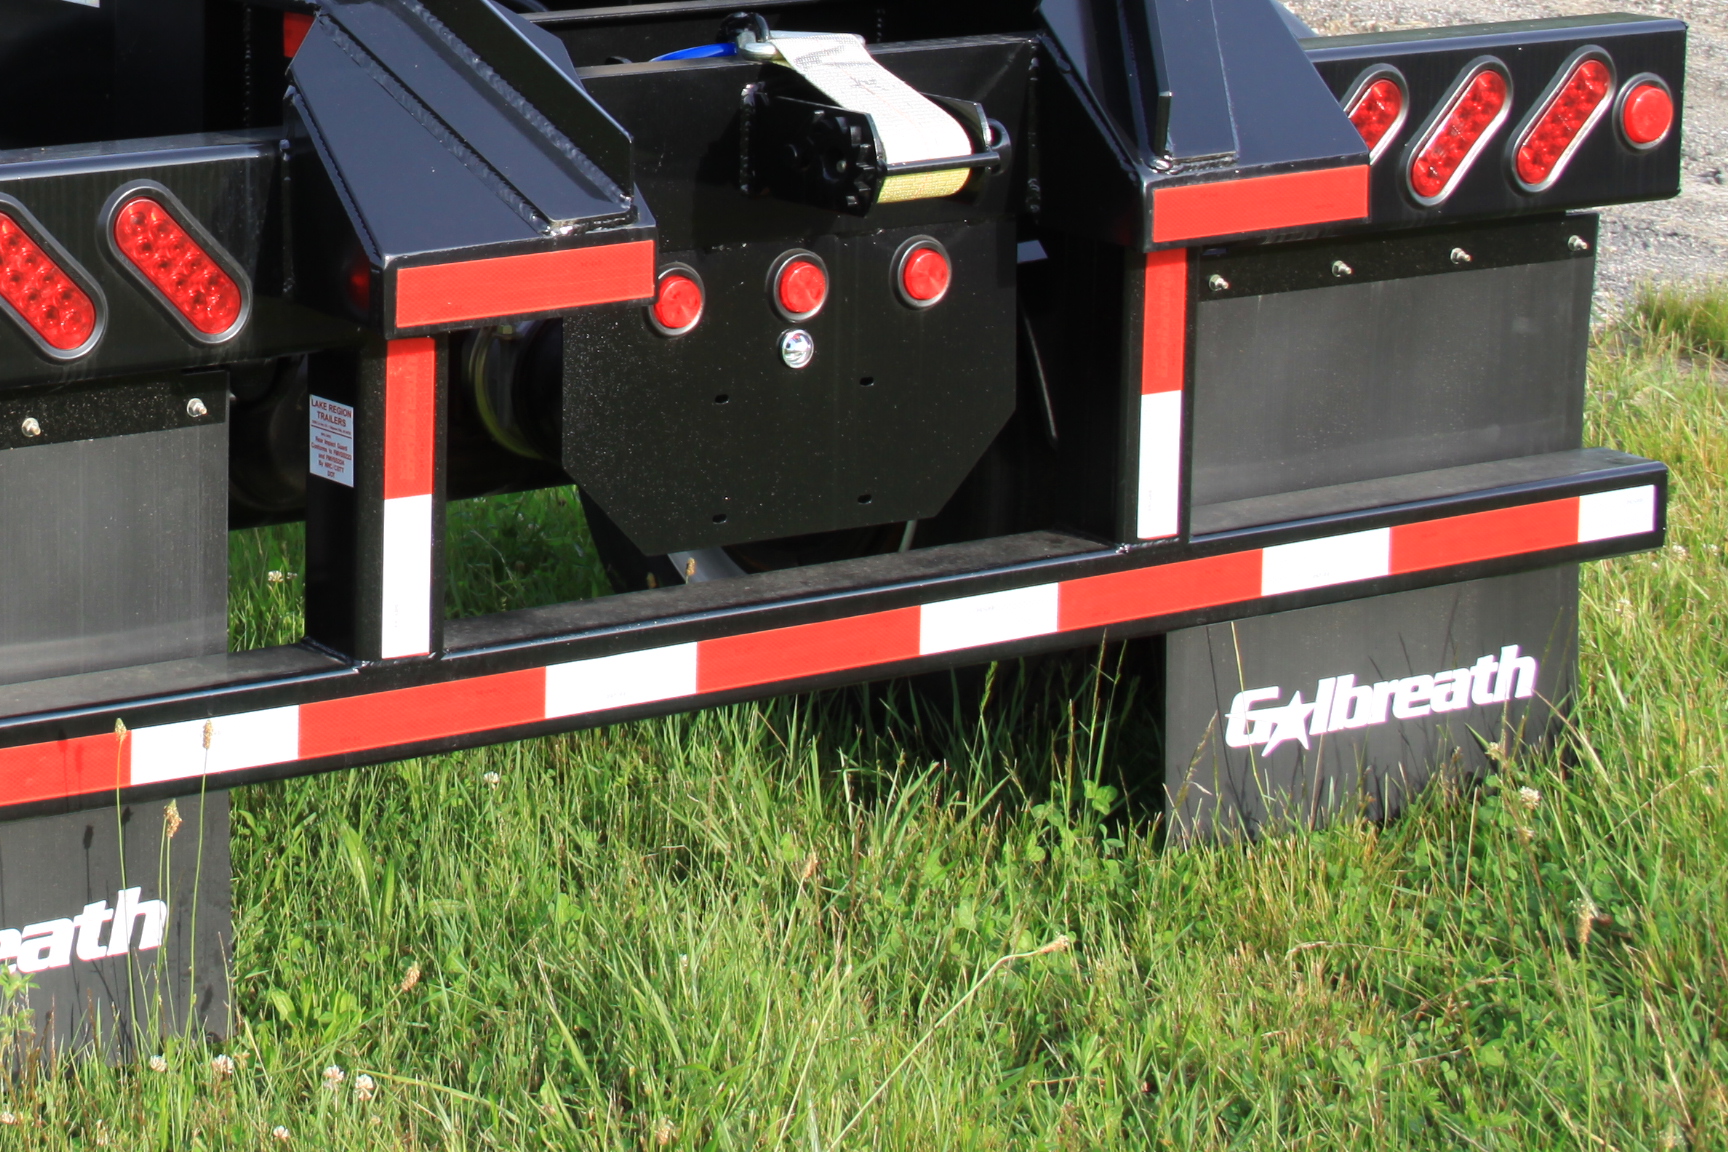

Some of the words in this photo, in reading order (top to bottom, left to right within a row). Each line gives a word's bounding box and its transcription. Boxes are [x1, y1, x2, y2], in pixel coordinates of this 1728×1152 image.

[311, 398, 327, 411] LAKE
[328, 403, 351, 418] REGION
[317, 411, 347, 427] TRAILERS
